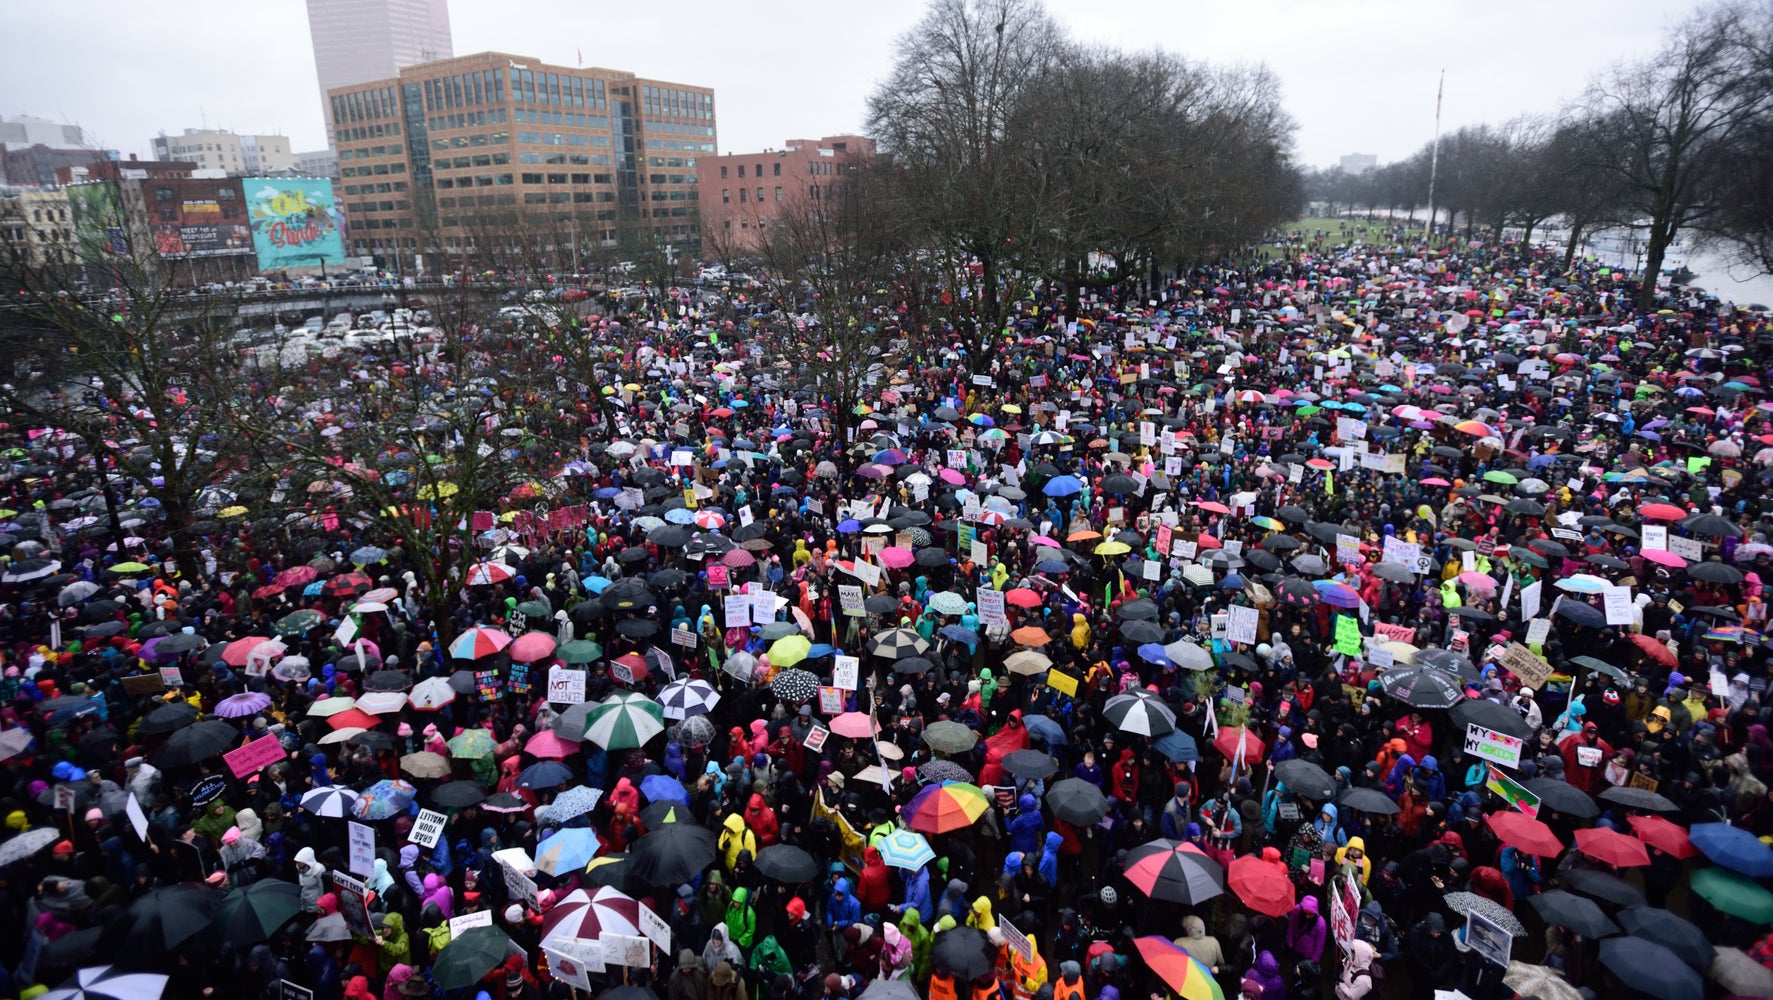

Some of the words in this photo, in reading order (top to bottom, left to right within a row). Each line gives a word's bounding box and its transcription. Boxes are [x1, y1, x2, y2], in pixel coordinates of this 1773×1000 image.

[552, 672, 564, 680] WE
[566, 672, 584, 682] WILL
[550, 680, 571, 690] NOT
[572, 681, 583, 691] BE
[549, 691, 583, 702] SILENCED
[1470, 725, 1489, 737] MY
[1465, 738, 1480, 751] MY
[194, 781, 225, 801] HUMANS
[200, 783, 214, 793] ALL
[419, 811, 445, 824] WALLET
[418, 822, 436, 834] YOUR
[413, 831, 433, 844] GRAB
[333, 875, 349, 888] CAN'T
[349, 881, 364, 894] EVEN
